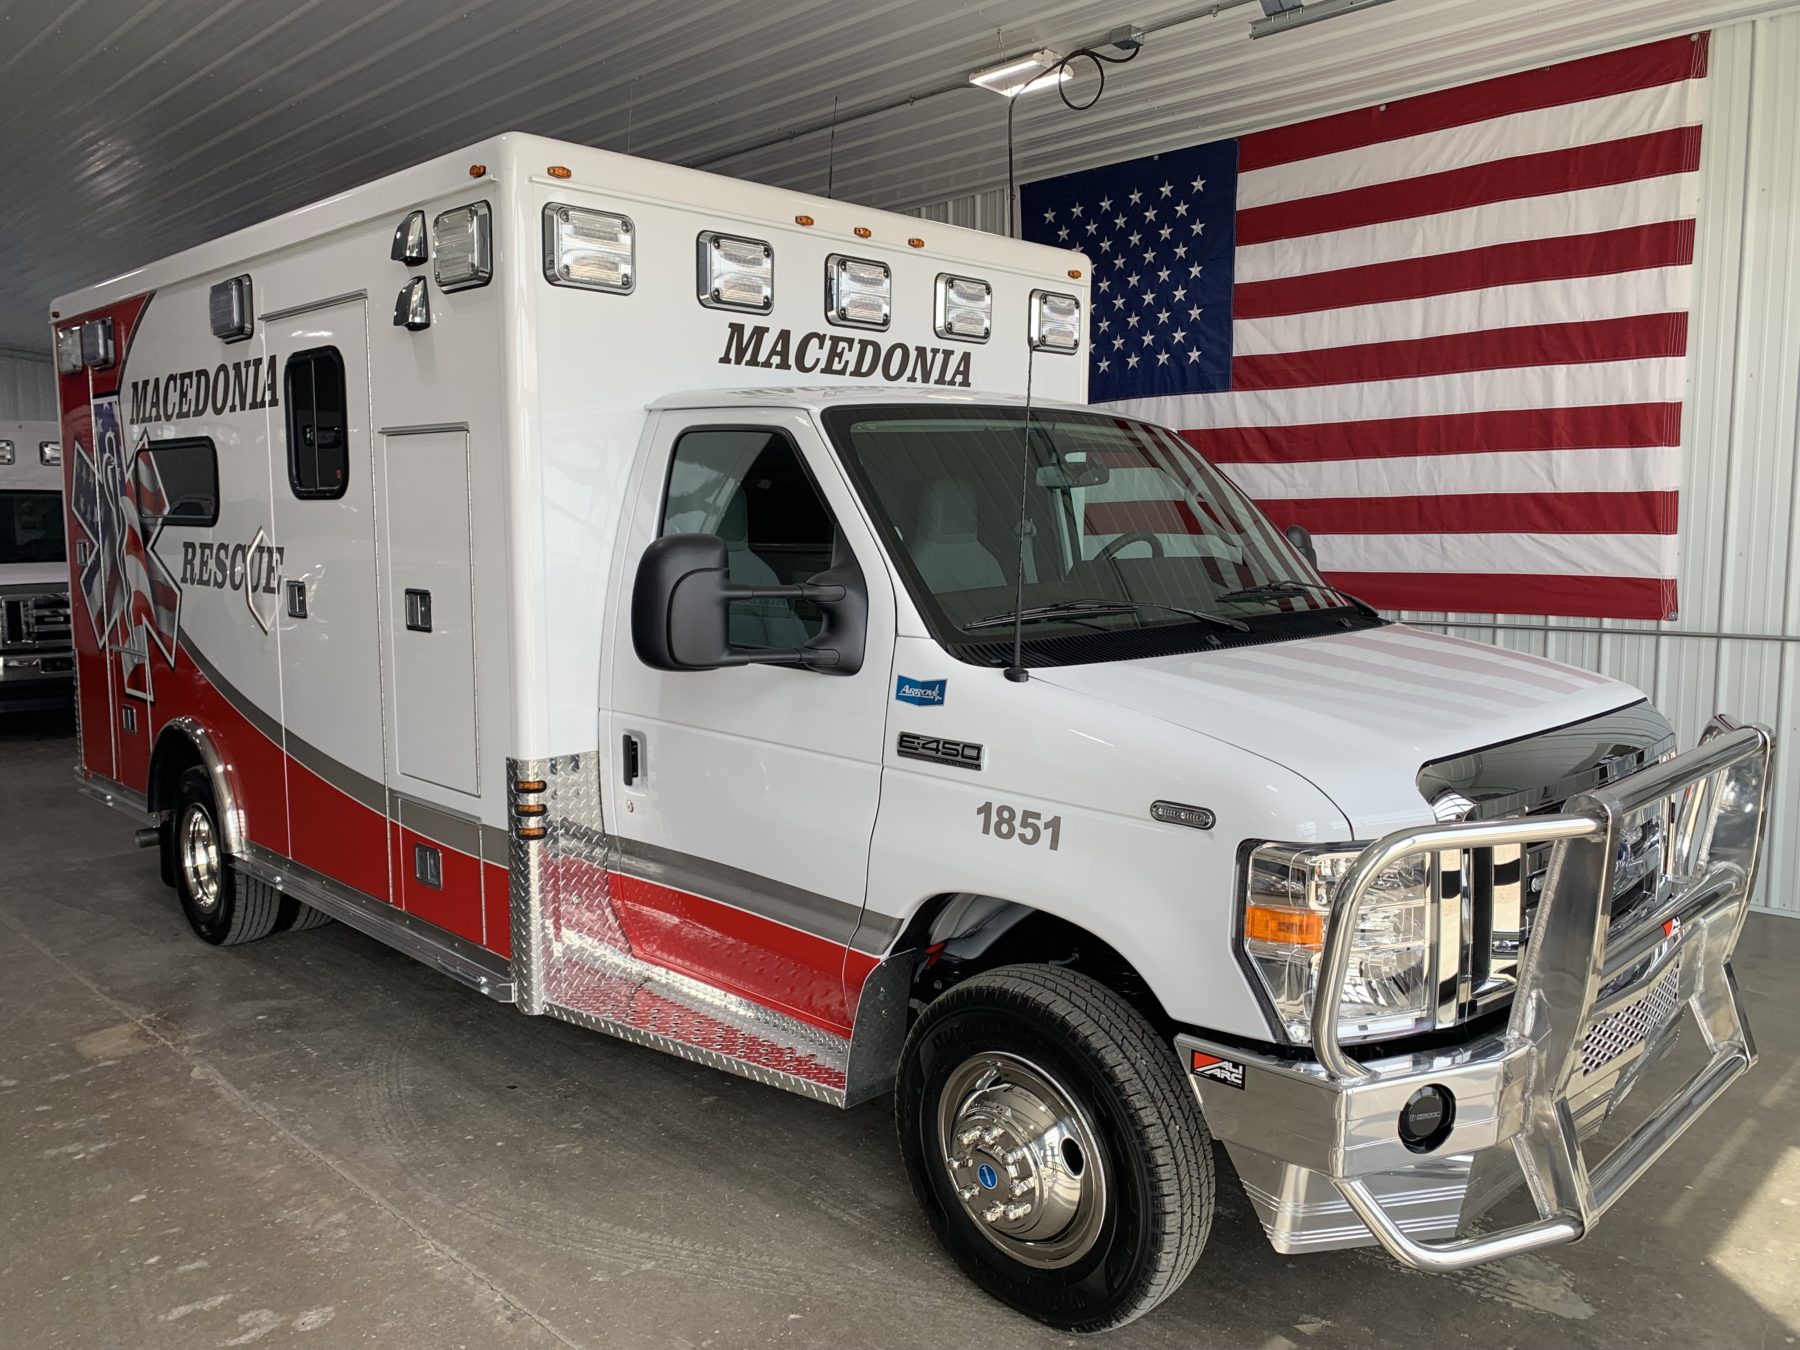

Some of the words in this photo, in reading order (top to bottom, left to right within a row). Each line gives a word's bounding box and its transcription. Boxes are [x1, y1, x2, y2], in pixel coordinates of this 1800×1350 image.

[718, 322, 972, 387] MACEDONIA
[130, 354, 279, 425] MACEDONIA
[180, 541, 285, 595] RESCUE
[899, 684, 938, 698] ARROW
[976, 801, 1061, 851] 1851
[1195, 1061, 1243, 1074] ALI
[1203, 1068, 1243, 1084] ARC
